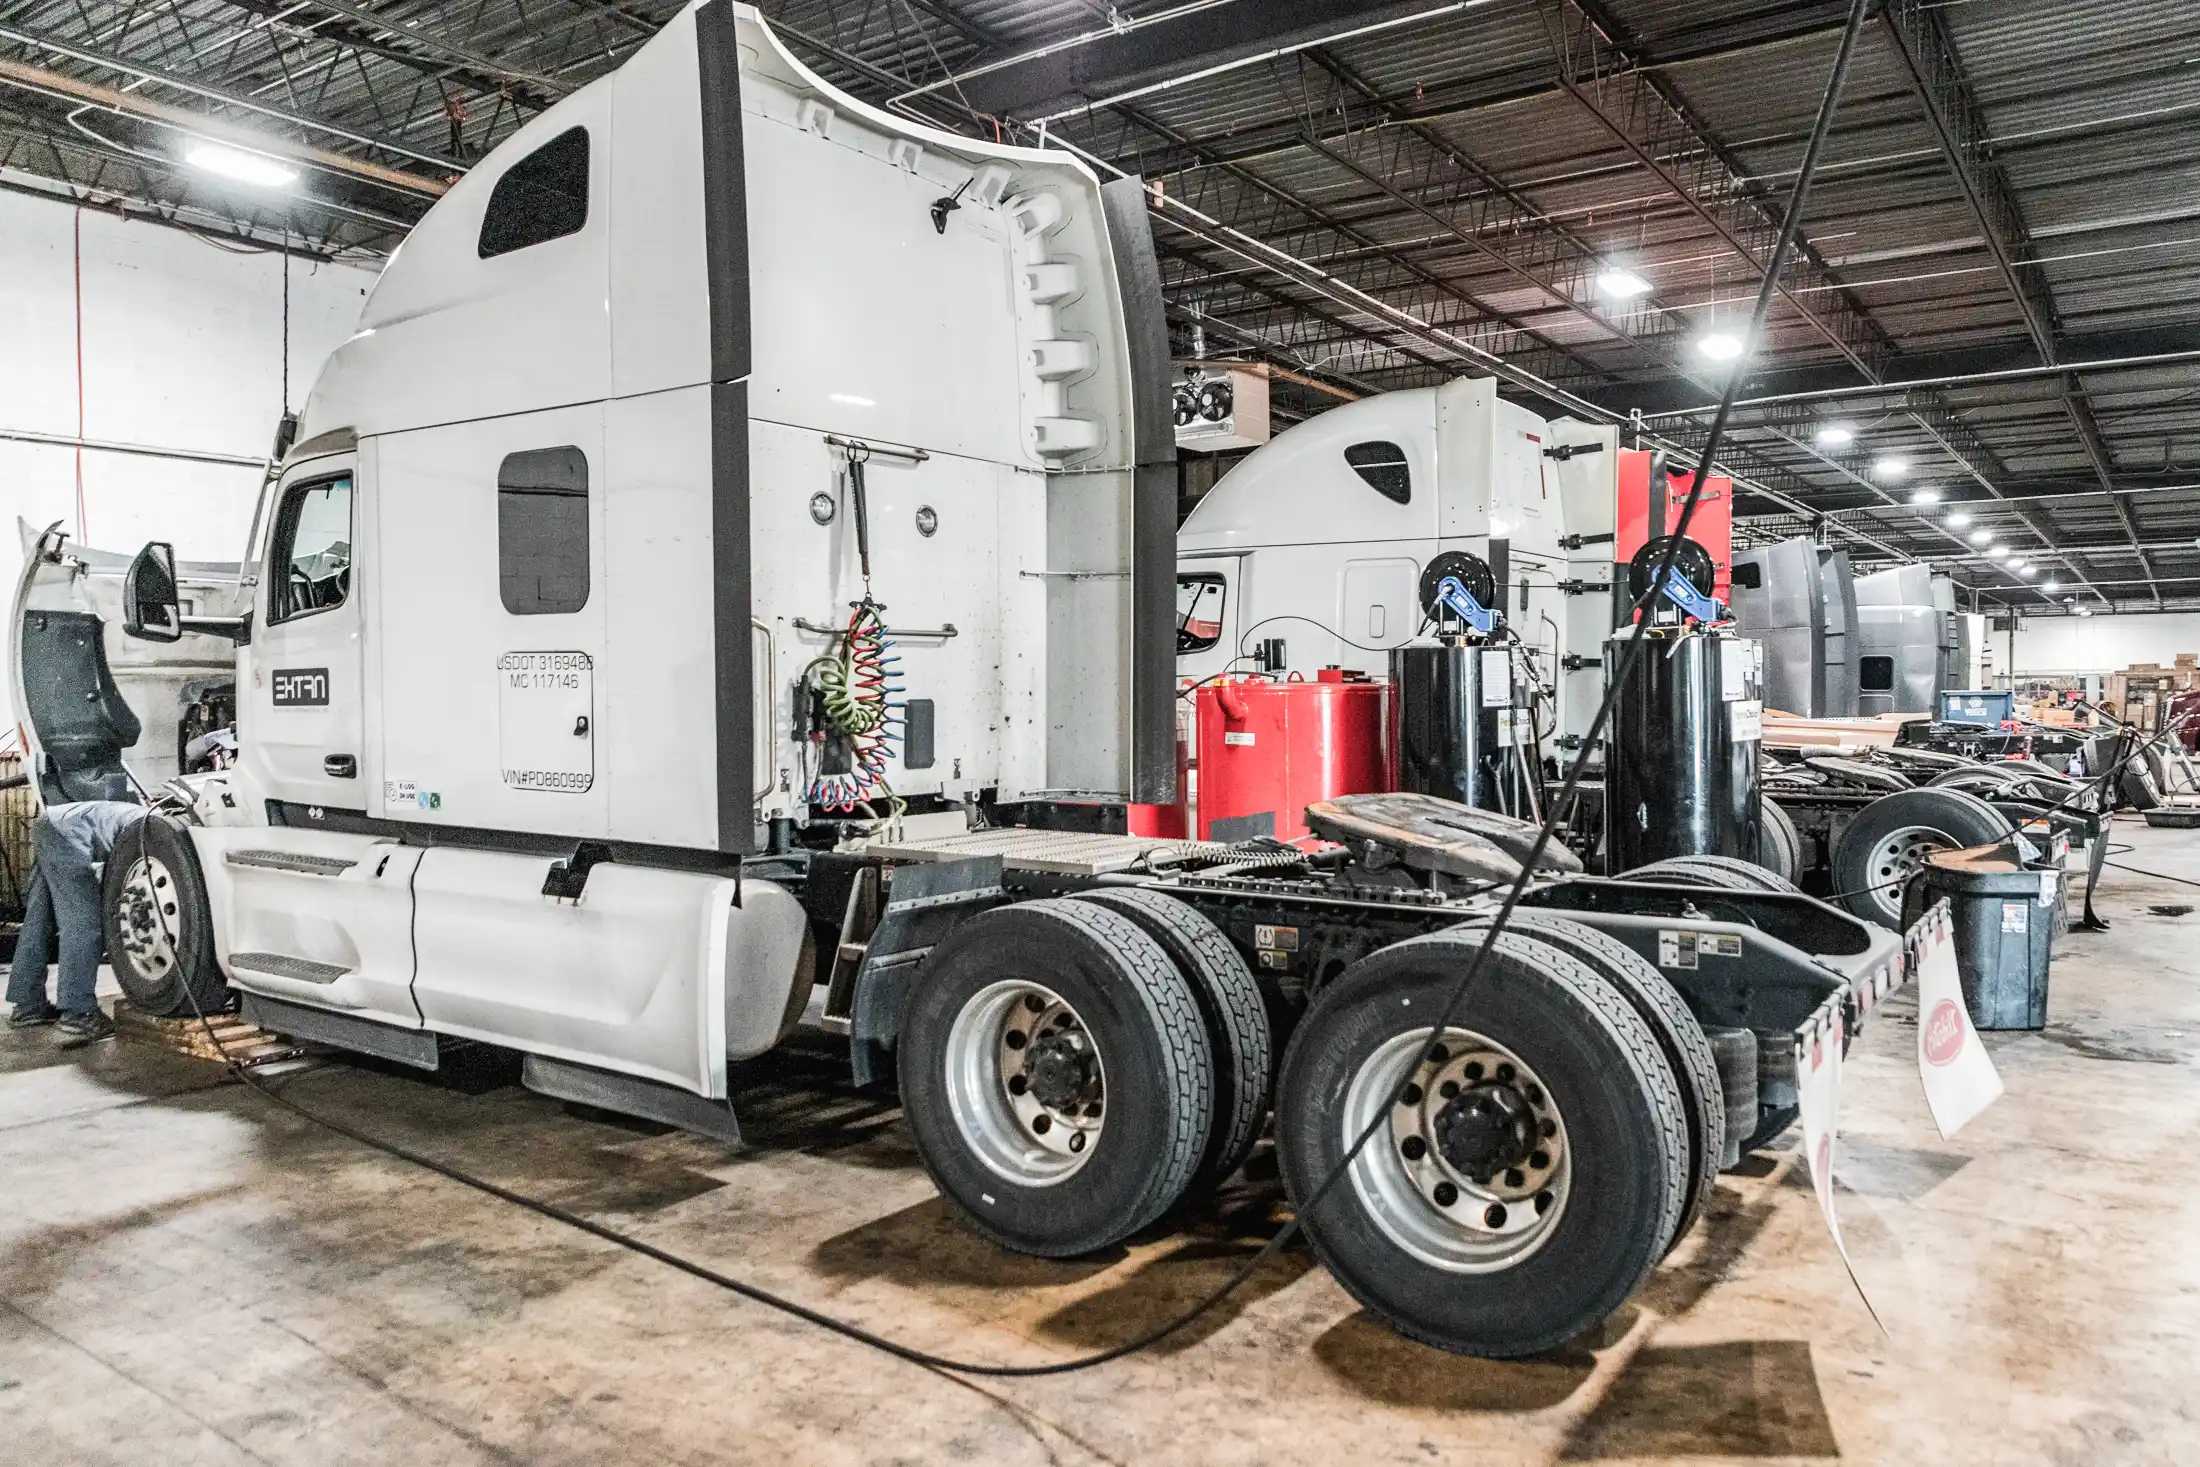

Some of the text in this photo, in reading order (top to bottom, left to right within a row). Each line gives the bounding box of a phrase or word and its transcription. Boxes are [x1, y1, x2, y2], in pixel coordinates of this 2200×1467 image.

[496, 655, 594, 671] USDOT 3169488
[510, 673, 579, 689] MC 117146
[501, 769, 592, 789] VIN#PD860999
